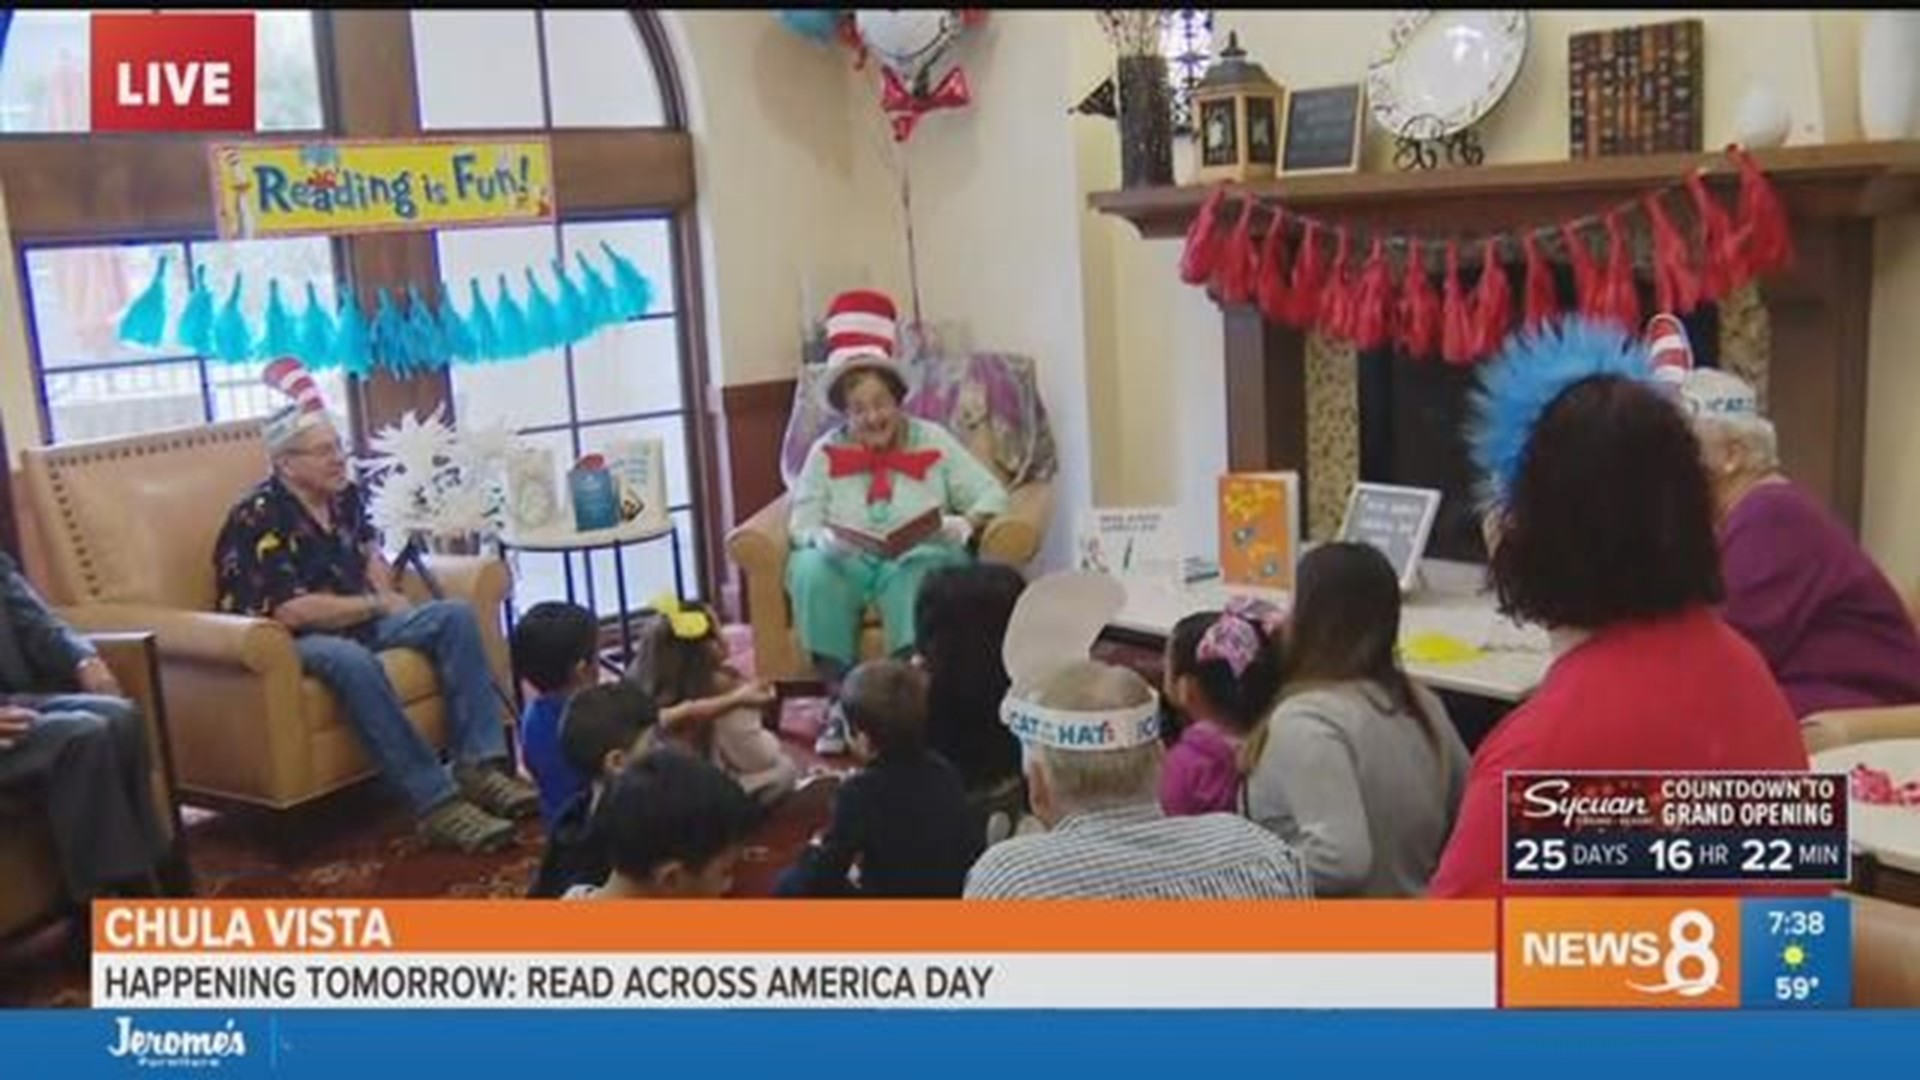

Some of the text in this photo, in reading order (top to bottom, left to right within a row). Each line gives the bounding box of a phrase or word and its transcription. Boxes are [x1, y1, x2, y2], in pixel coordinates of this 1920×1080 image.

[253, 153, 530, 219] Reading is Fun!
